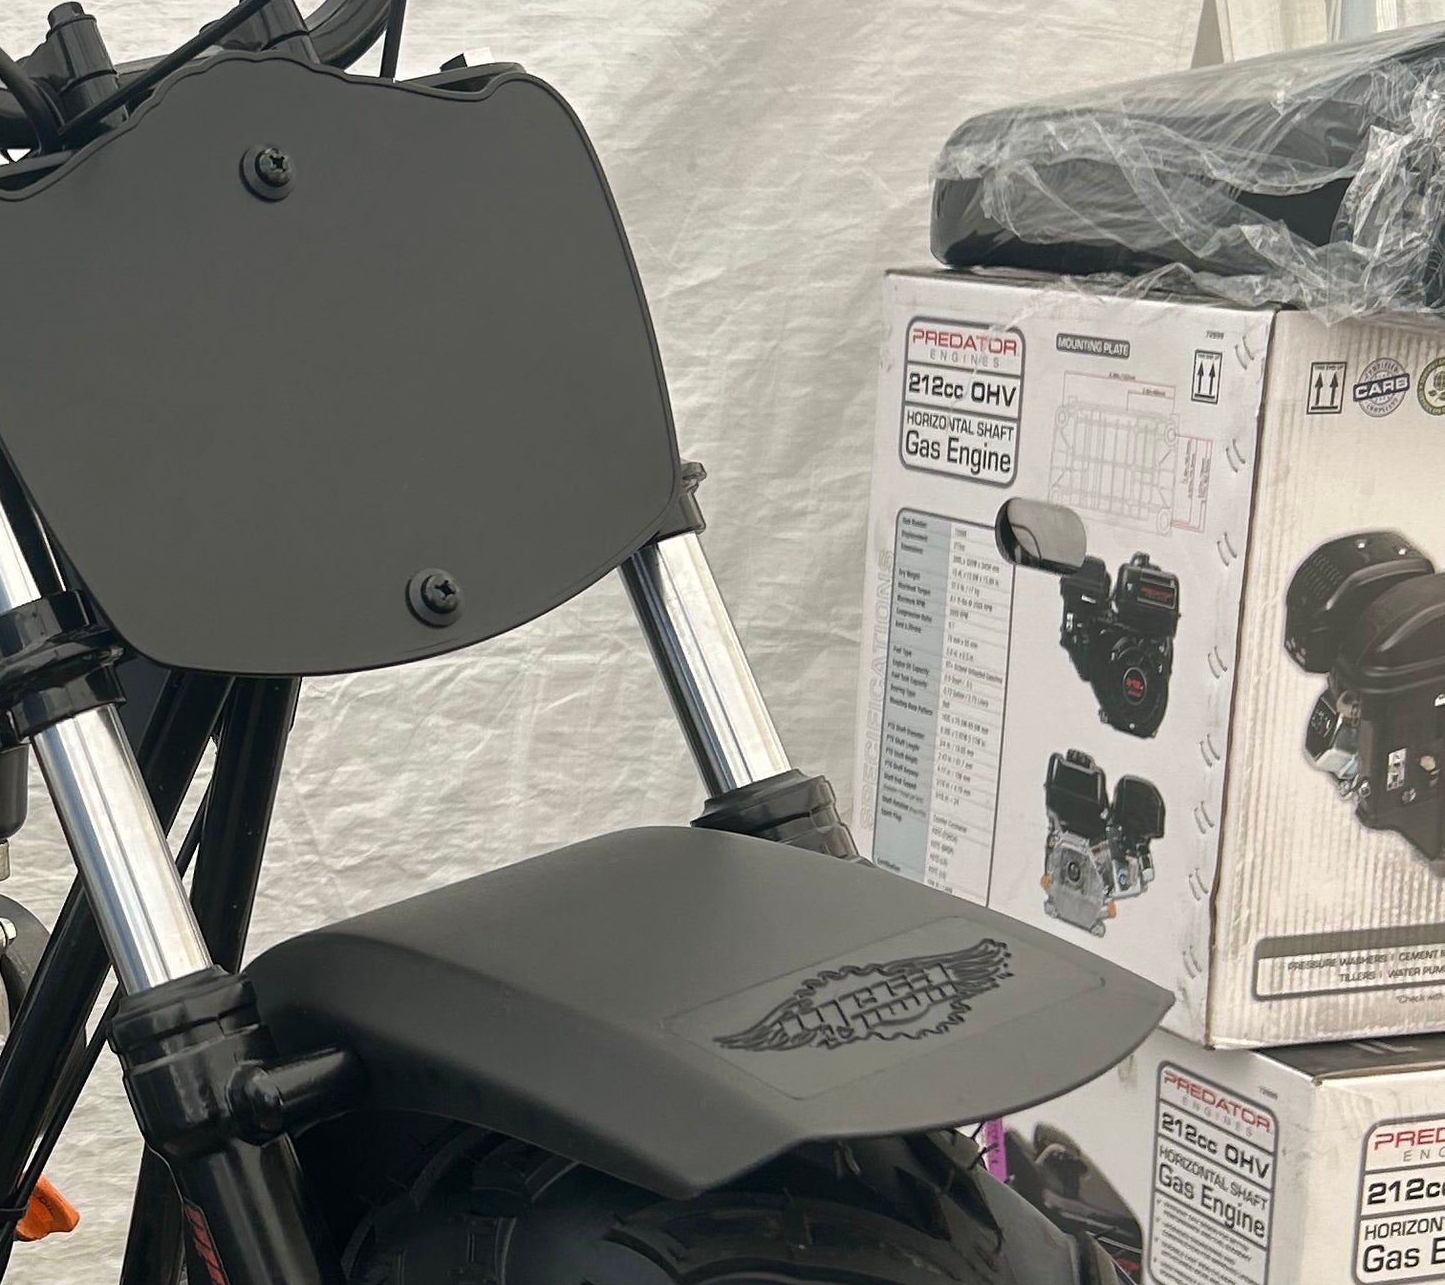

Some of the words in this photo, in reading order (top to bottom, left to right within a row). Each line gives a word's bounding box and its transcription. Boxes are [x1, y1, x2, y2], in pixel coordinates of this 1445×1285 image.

[912, 328, 1017, 356] PREDATOR
[1058, 336, 1102, 353] MOUNTING
[1104, 341, 1129, 356] PLATE
[930, 348, 1000, 369] ENGINES
[908, 373, 964, 400] 212cc
[971, 381, 1016, 407] OHV
[1356, 376, 1408, 399] CARB
[906, 410, 975, 436] HORIZONTAL
[977, 421, 1014, 442] SHAFT
[905, 430, 941, 460] Gas
[947, 436, 1011, 475] Engine
[1339, 953, 1387, 966] WASHERS
[1398, 949, 1438, 961] CEMENT
[1388, 966, 1420, 978] WATER
[1164, 1070, 1271, 1132] PREDATOR
[1162, 1112, 1218, 1154] 212cc
[1224, 1143, 1270, 1179] OHV
[1159, 1145, 1228, 1192] HORIZONTAL
[1230, 1181, 1268, 1211] SHAFT
[1158, 1163, 1194, 1200] Gas
[1201, 1184, 1265, 1239] Engine
